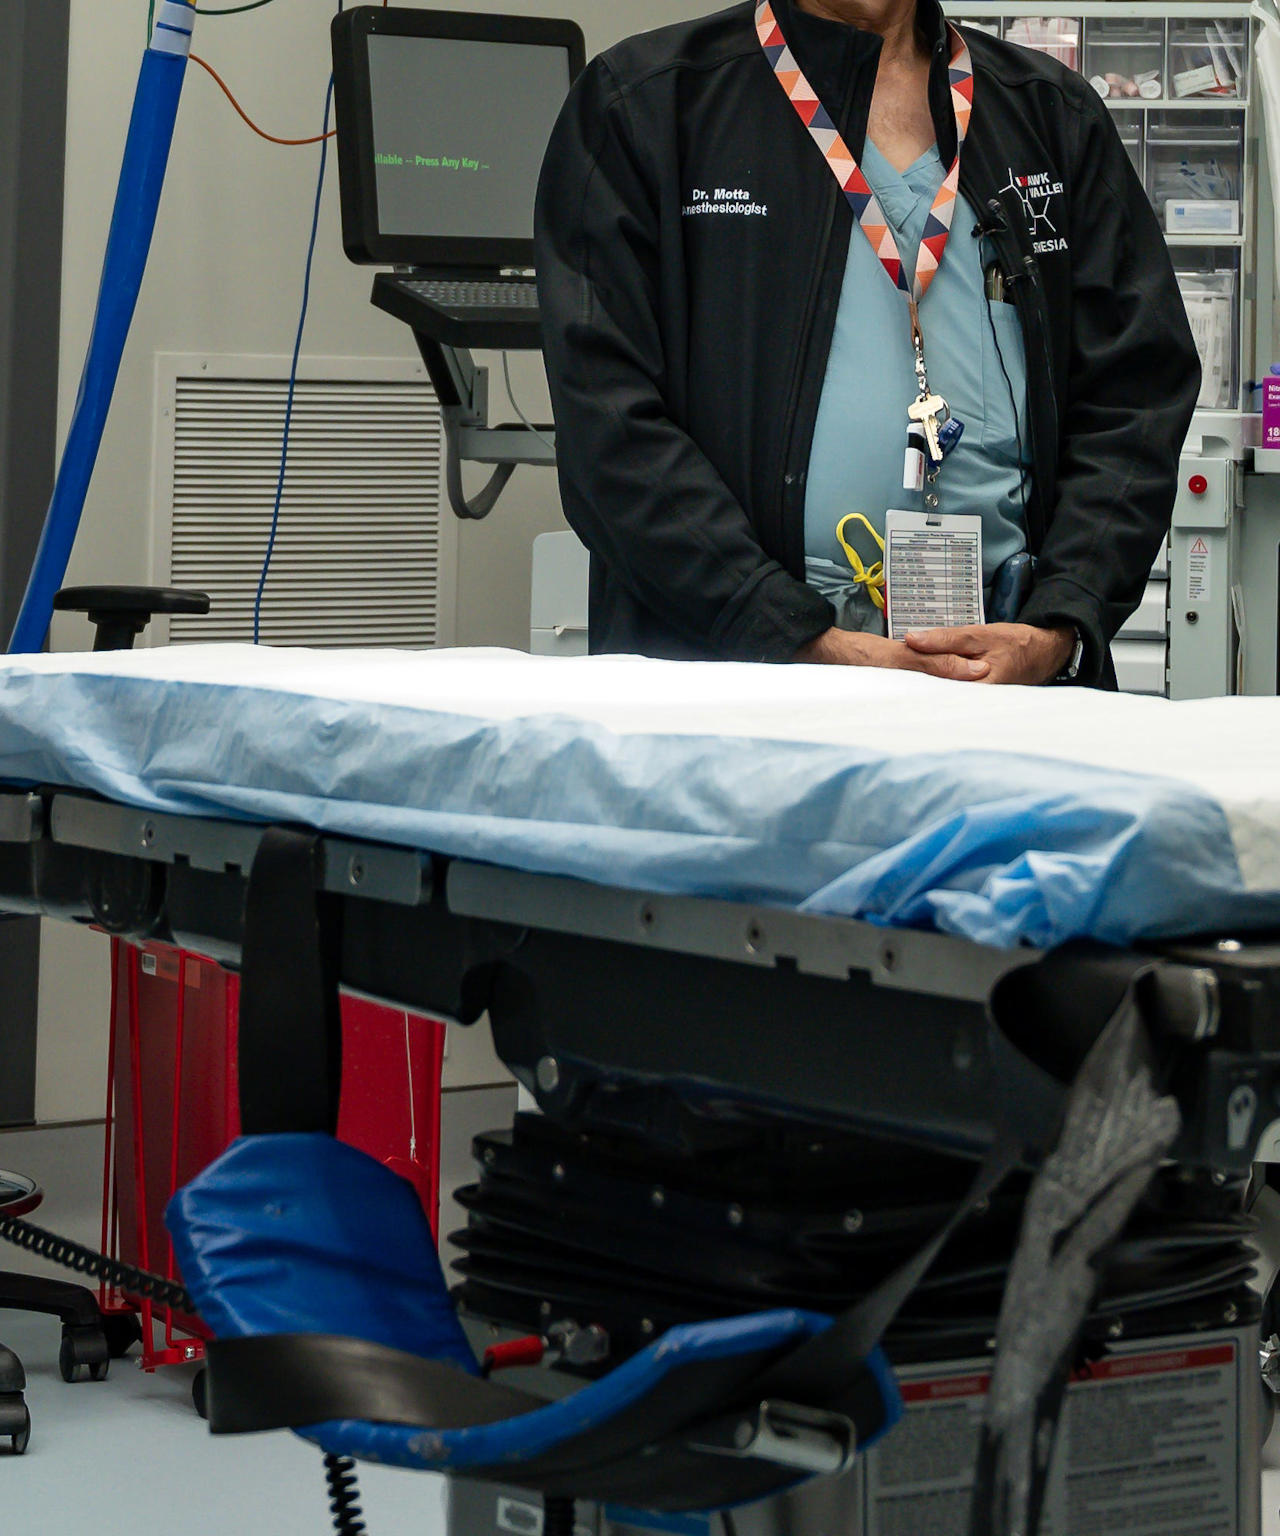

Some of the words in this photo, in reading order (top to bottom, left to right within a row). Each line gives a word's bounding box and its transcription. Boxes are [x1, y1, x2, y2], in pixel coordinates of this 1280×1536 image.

[415, 155, 439, 166] Press
[442, 156, 460, 170] Any
[462, 157, 479, 171] Key
[693, 189, 709, 201] Dr.
[714, 189, 750, 200] Motta
[682, 201, 768, 216] Anesthesiologist
